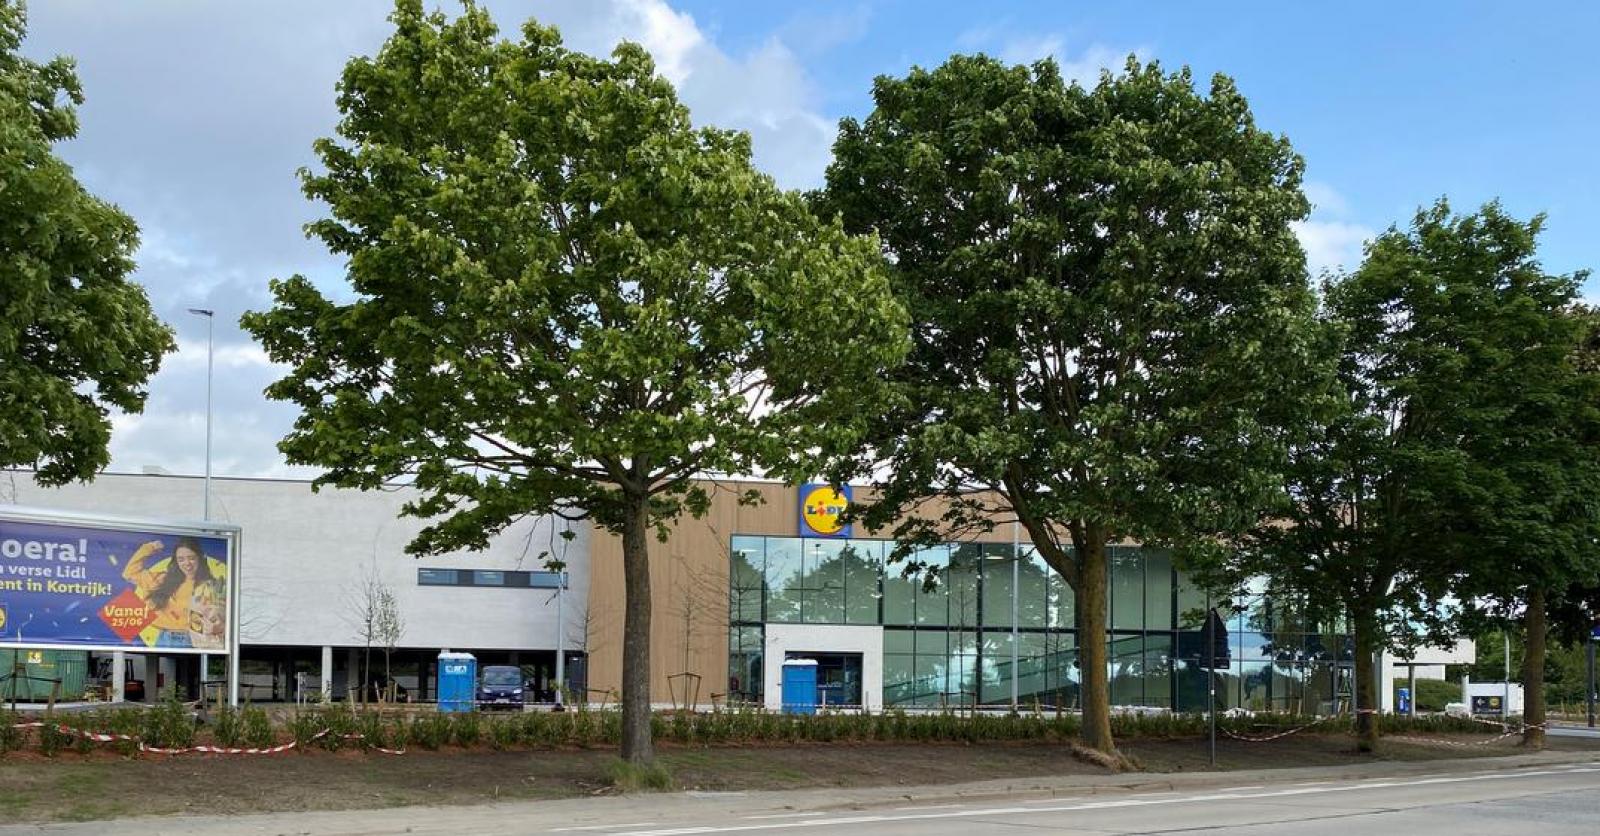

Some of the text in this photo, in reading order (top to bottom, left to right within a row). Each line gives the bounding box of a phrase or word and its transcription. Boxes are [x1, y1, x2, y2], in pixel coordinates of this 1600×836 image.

[2, 539, 88, 562] oera!
[8, 565, 52, 577] verse
[57, 565, 86, 579] Lidl
[26, 578, 43, 592] in
[47, 580, 112, 597] Kortrijk!
[104, 602, 149, 618] Vanaf
[111, 617, 143, 628] 25/06
